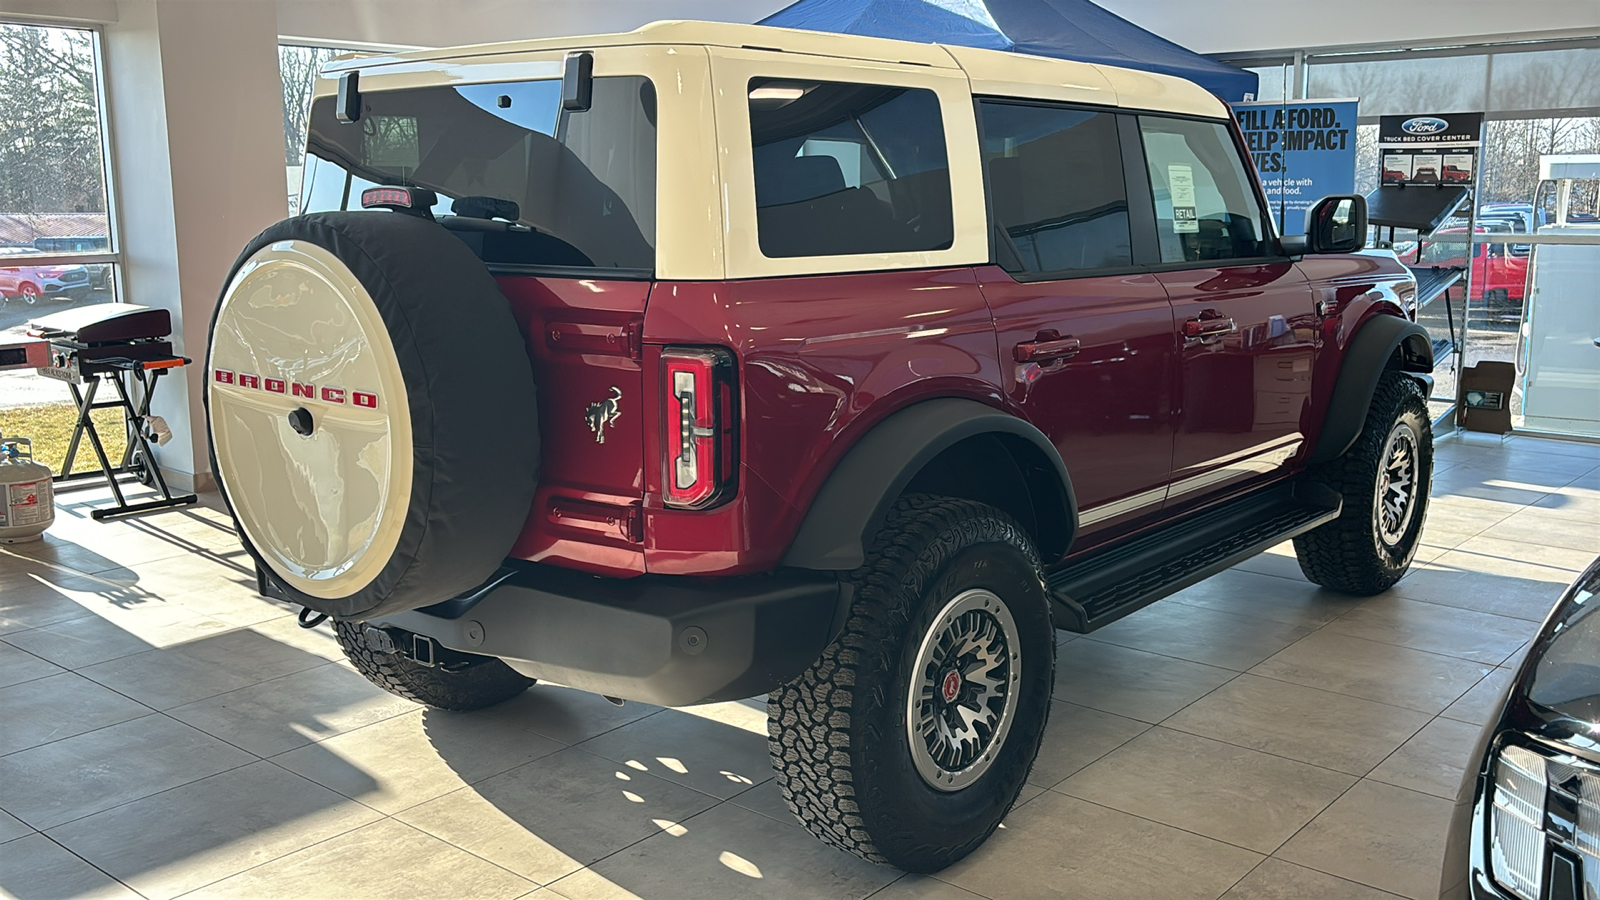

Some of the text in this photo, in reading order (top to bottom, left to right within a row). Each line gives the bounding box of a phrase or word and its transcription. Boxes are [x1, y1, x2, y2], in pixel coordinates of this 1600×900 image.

[1236, 108, 1341, 130] FILL A FORD.
[1409, 120, 1438, 132] Ford
[1244, 131, 1278, 151] ELP
[1251, 152, 1287, 173] VES.
[1268, 178, 1295, 186] vehcle
[1296, 178, 1313, 186] with
[1266, 187, 1281, 195] and
[1175, 209, 1196, 219] RETAIL
[214, 368, 379, 410] BRONCO
